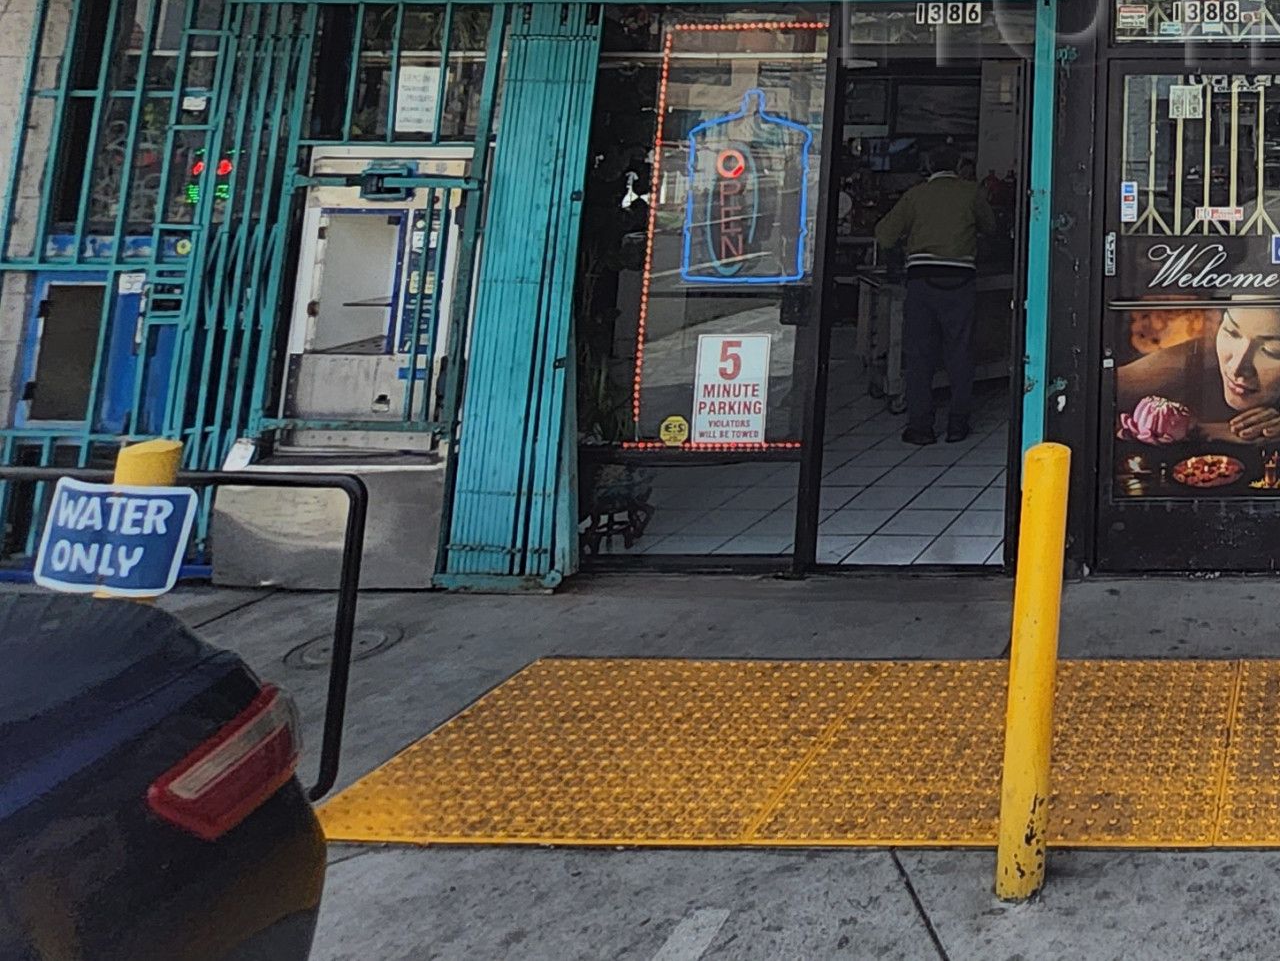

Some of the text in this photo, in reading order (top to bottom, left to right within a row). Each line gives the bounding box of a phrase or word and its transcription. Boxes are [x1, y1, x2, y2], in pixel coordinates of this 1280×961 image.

[917, 3, 982, 24] 1386
[1173, 2, 1238, 22] 1388
[716, 148, 745, 260] OPEN
[1148, 243, 1280, 288] Welcome
[718, 340, 742, 380] 5
[703, 383, 760, 399] MINUTE
[698, 400, 762, 416] PARKING
[708, 419, 751, 428] VIOLATORS
[698, 430, 759, 439] WILL BE TOWED
[57, 491, 175, 535] WATER
[50, 538, 145, 578] ONLY
